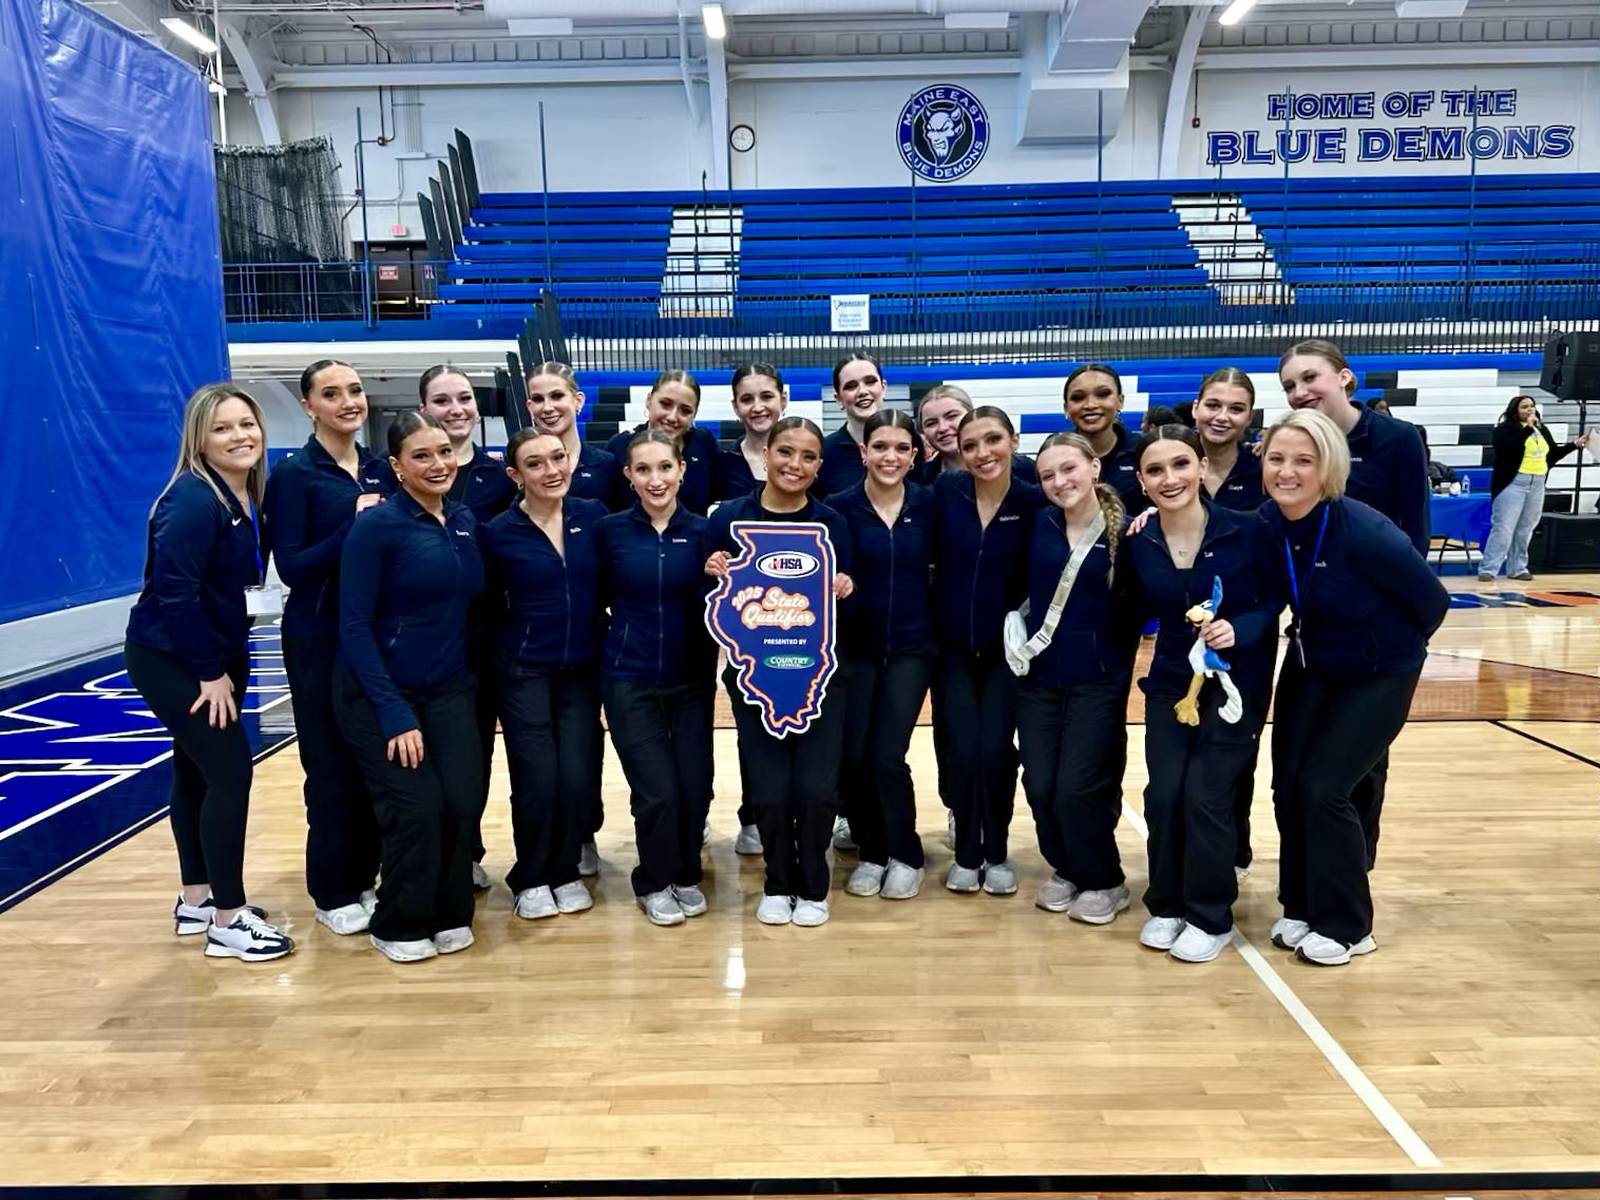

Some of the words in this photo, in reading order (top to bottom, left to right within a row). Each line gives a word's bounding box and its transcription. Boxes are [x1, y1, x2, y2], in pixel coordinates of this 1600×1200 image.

[903, 89, 945, 126] MAINE
[950, 91, 983, 123] EAST
[1267, 91, 1375, 120] HOME
[1382, 90, 1435, 118] OF
[1441, 89, 1517, 117] THE
[903, 142, 930, 174] BLUE
[934, 141, 983, 177] DEMONS
[1206, 127, 1347, 165] BLUE
[1357, 125, 1575, 162] DEMONS
[763, 588, 808, 609] State
[742, 602, 815, 629] Qualifier
[770, 656, 809, 665] COUNTRY
